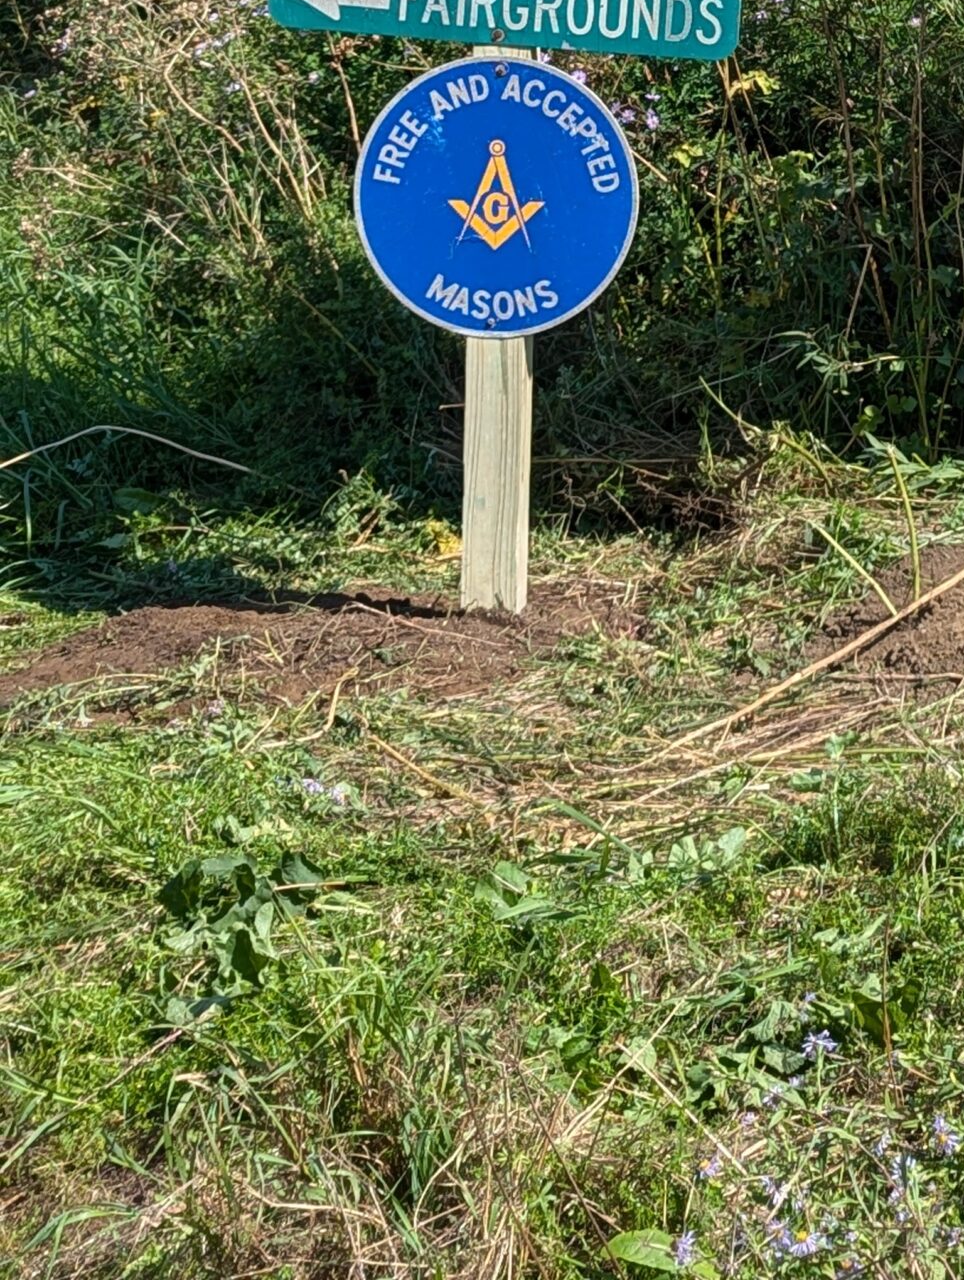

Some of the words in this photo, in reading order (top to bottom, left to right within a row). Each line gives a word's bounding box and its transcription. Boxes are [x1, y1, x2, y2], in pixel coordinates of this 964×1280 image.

[373, 109, 427, 185] FREE
[428, 73, 490, 121] AND
[501, 73, 621, 195] ACCEPTED
[482, 192, 509, 224] G
[425, 273, 559, 321] MASONS
